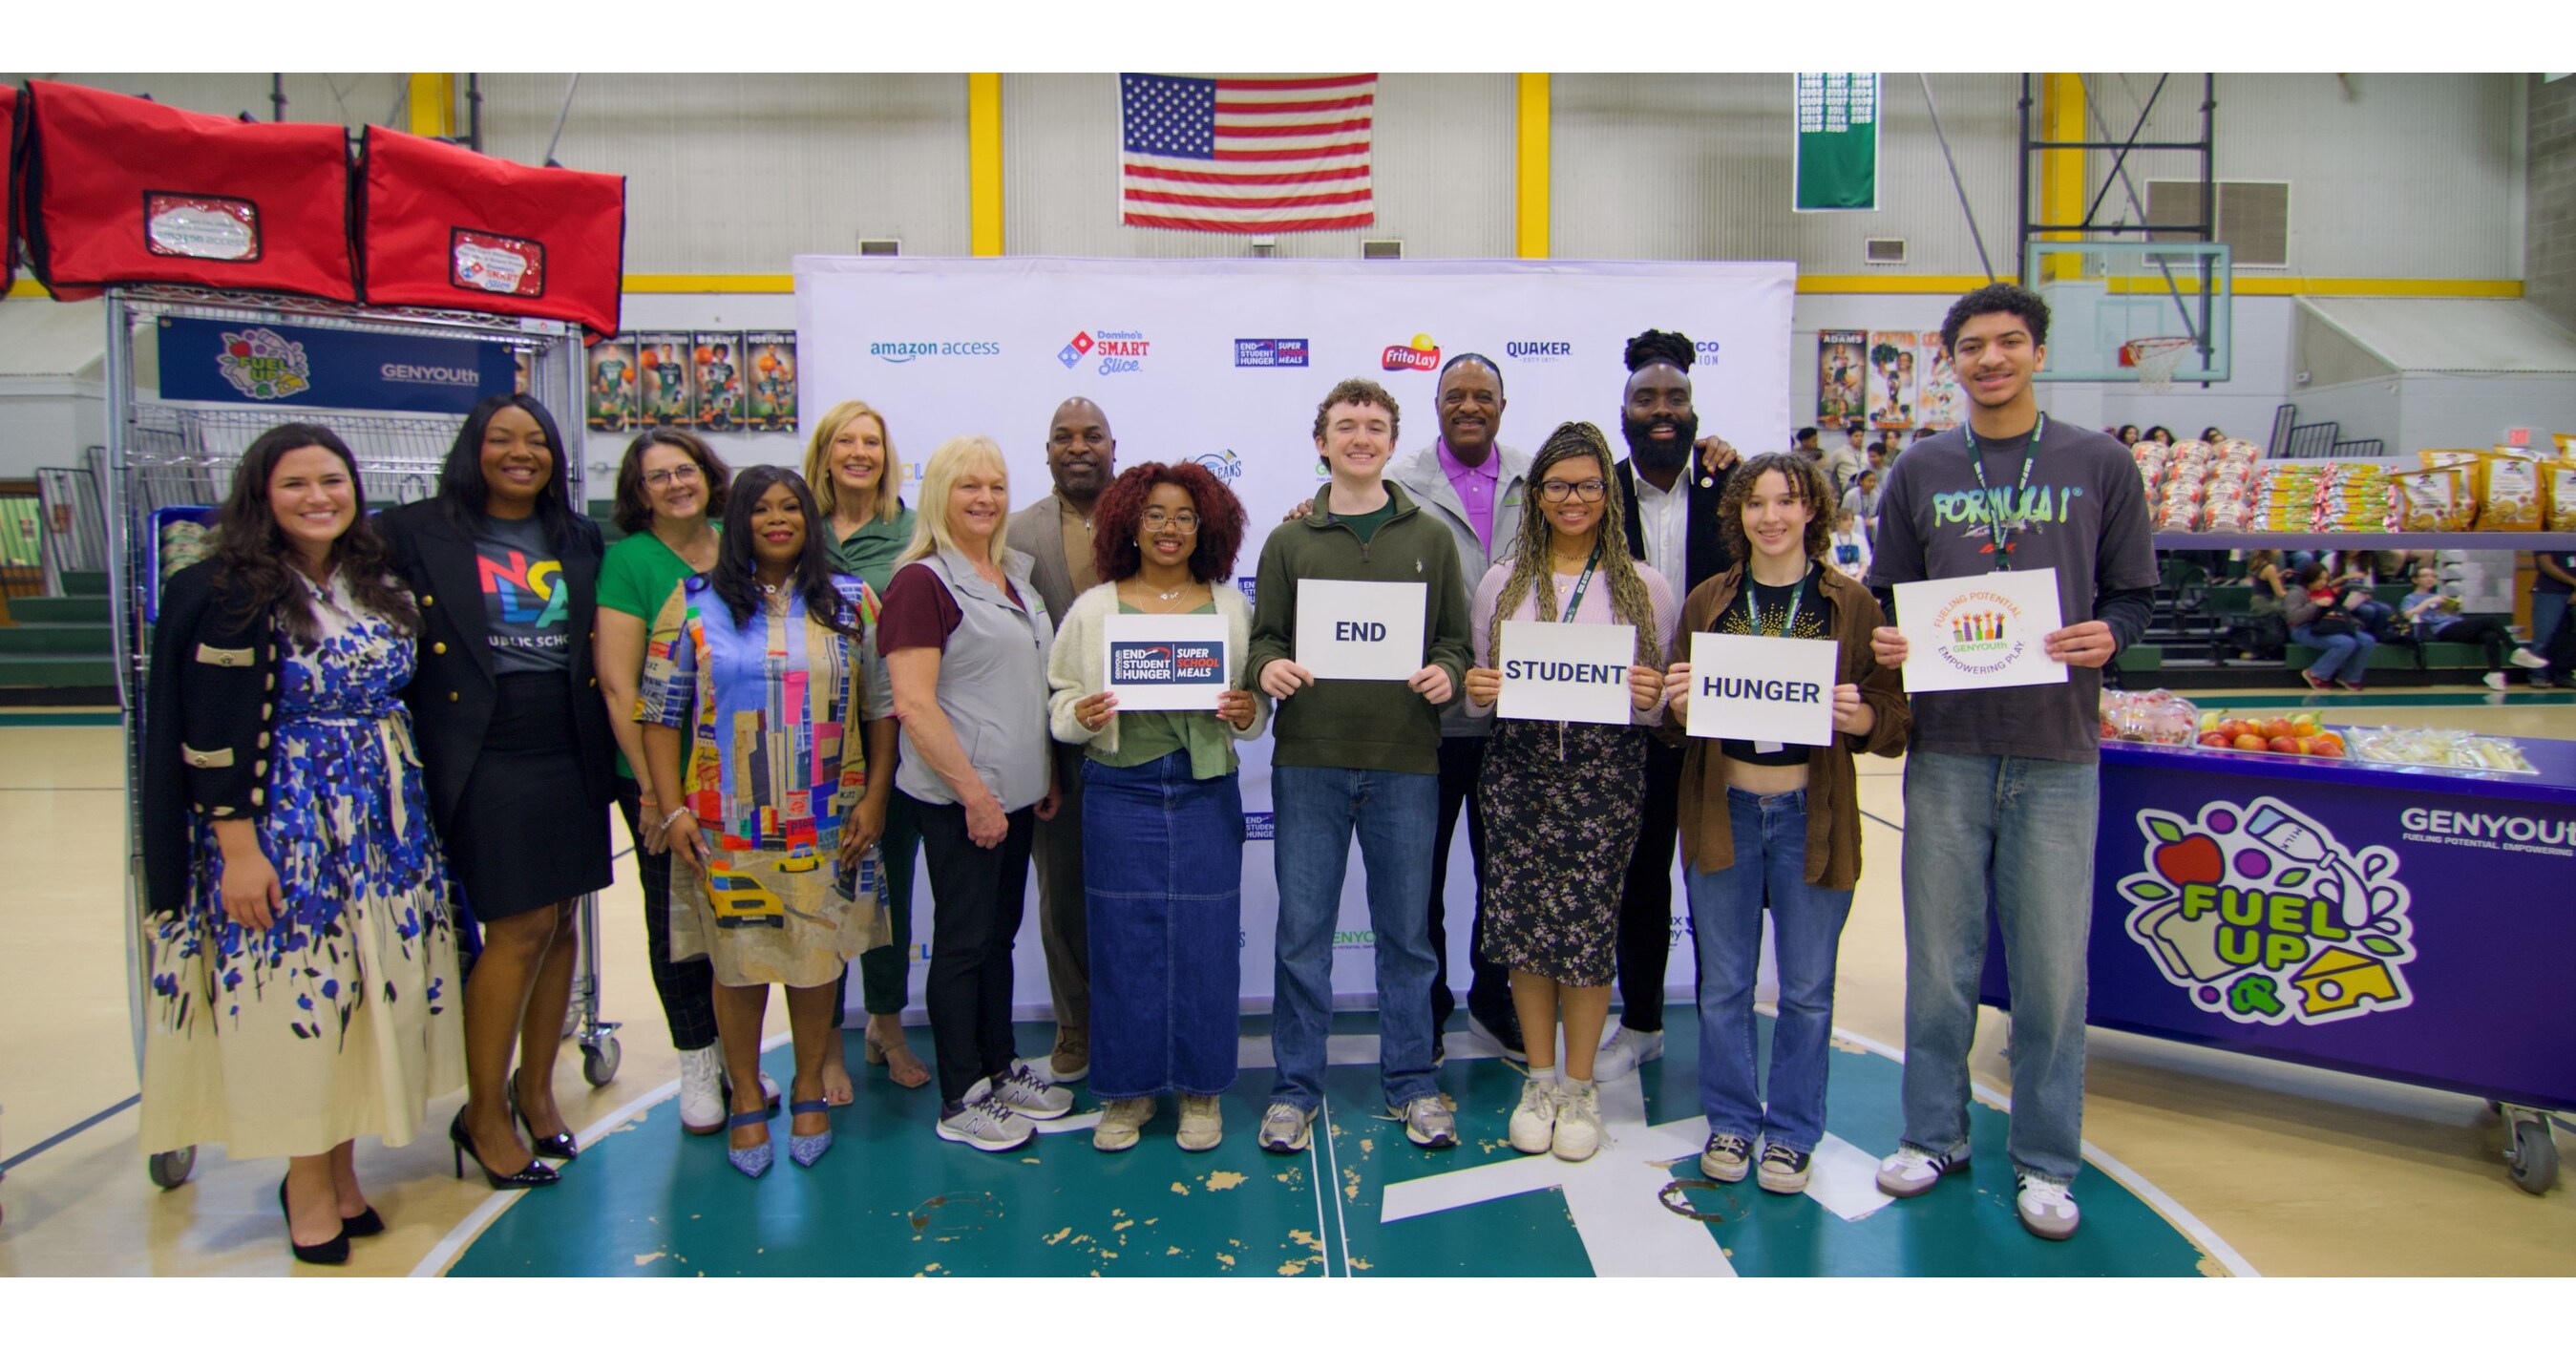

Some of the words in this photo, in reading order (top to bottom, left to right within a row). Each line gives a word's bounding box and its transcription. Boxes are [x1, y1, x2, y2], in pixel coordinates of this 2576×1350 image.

[1097, 330, 1143, 340] Domino's
[1824, 335, 1863, 344] ADAMS
[871, 342, 938, 356] amazon
[941, 342, 1000, 355] access
[1098, 341, 1150, 356] SMART
[1507, 342, 1571, 358] QUAKER
[239, 356, 287, 372] FUEL
[1098, 357, 1140, 375] Slice
[250, 369, 278, 383] UP
[381, 363, 479, 383] GENYOUth
[1932, 485, 2053, 528] FORMULA
[1933, 594, 1968, 628] FUELING
[1969, 592, 2022, 620] POTENTIAL
[1336, 622, 1386, 642] END
[488, 635, 533, 647] UBLIC
[1953, 642, 2008, 653] GENYOUth
[1123, 649, 1146, 659] END
[1176, 648, 1210, 658] SUPER
[1938, 645, 2006, 675] EMPOWERING
[1123, 660, 1171, 668] STUDENT
[1176, 658, 1219, 667] SCHOOL
[1123, 669, 1171, 679] HUNGER
[1177, 667, 1212, 677] MEALS
[1505, 660, 1627, 685] STUDENT
[1702, 676, 1820, 704] HUNGER
[2400, 807, 2576, 846] GENYOUt
[2280, 826, 2303, 851] MILK
[2402, 833, 2442, 844] FUELING
[2502, 842, 2574, 856] EMPOWERING
[2183, 884, 2349, 939] FUEL
[1332, 930, 1377, 943] ENYO
[2218, 926, 2309, 970] UP
